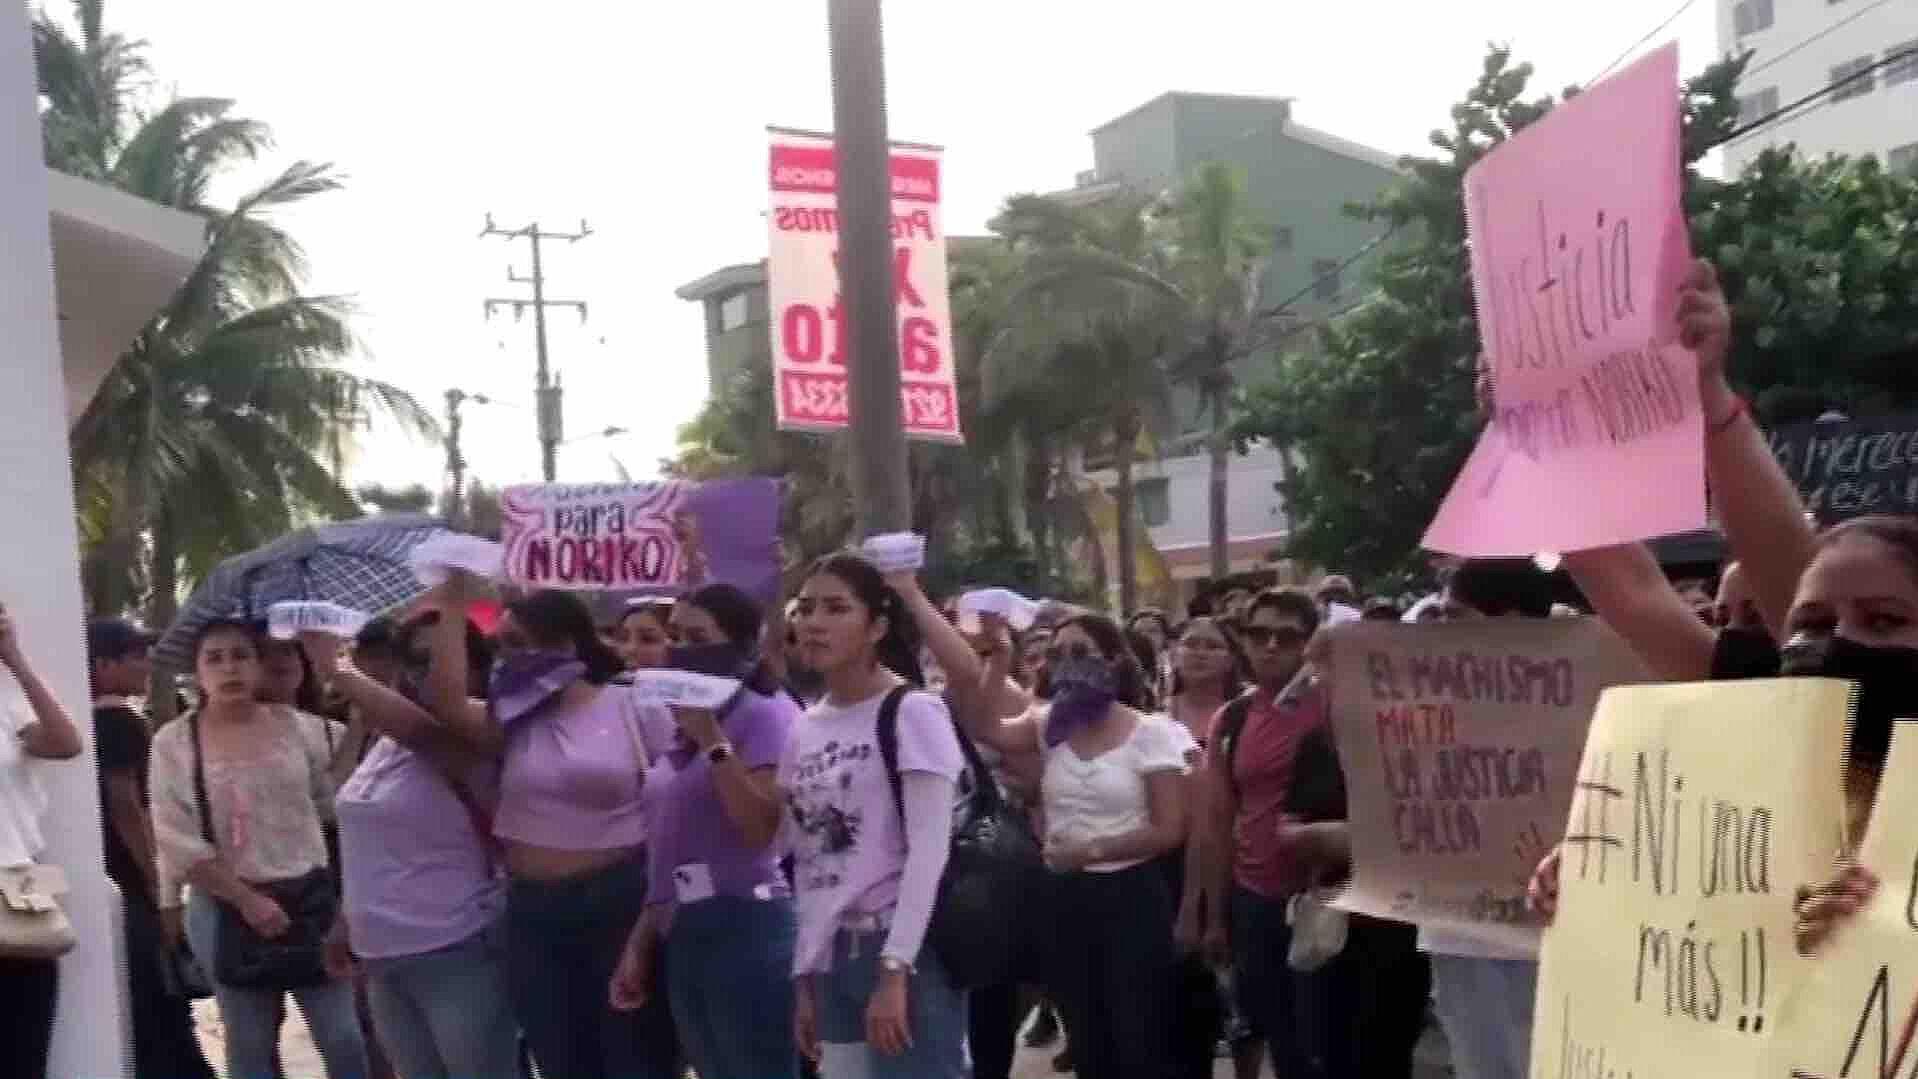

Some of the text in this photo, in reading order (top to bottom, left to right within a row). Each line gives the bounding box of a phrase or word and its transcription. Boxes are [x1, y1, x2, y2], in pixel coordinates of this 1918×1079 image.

[1579, 343, 1684, 446] NORIKO
[554, 501, 625, 537] para
[527, 536, 665, 583] NORIKO
[1407, 652, 1573, 706] MACHISMO
[1375, 702, 1456, 745] MATA
[1567, 748, 1686, 896] #Ni
[1700, 796, 1772, 898] una
